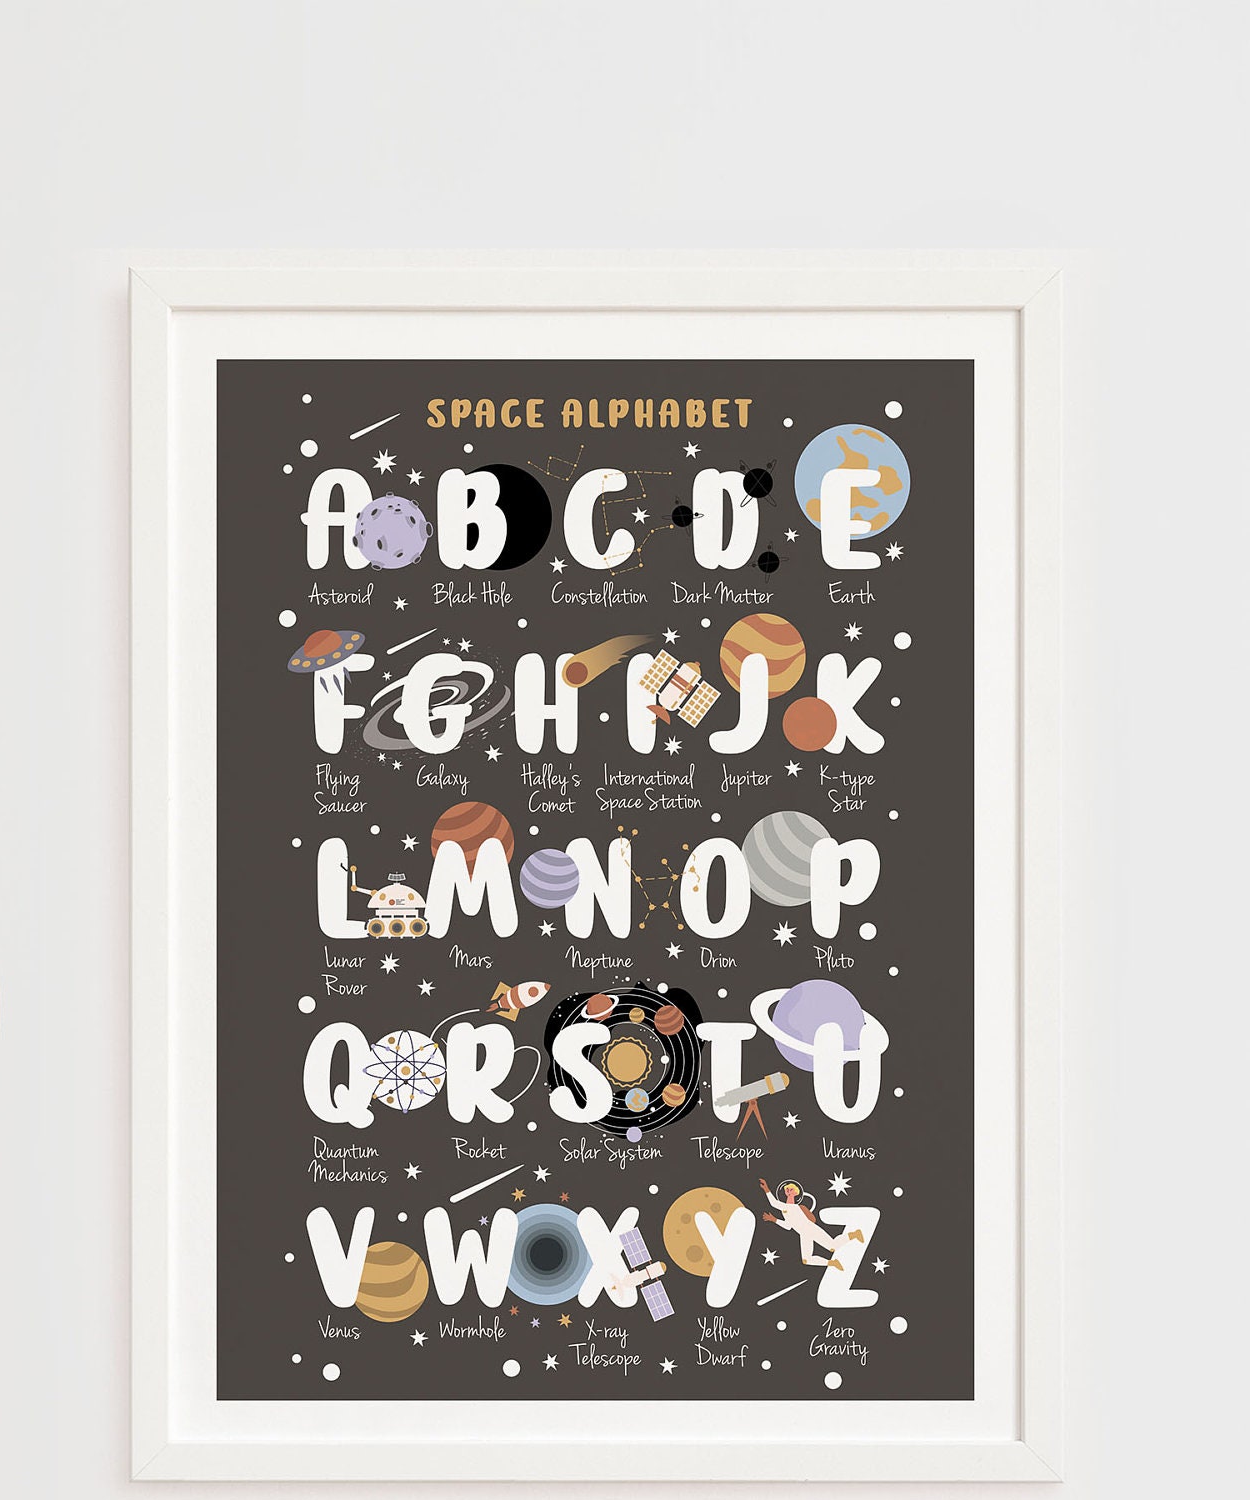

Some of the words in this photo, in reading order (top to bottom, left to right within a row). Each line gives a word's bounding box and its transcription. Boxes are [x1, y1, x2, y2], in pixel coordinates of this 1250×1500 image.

[426, 398, 545, 429] SPACE
[561, 398, 753, 429] ALPHABET
[300, 468, 373, 570] A
[437, 468, 508, 570] B
[563, 468, 635, 570] C
[692, 468, 760, 570] D
[820, 468, 882, 570] E
[308, 582, 373, 605] Asteroid
[432, 581, 477, 607] Black
[481, 581, 513, 607] Hole
[552, 581, 647, 607] Constellation
[671, 582, 710, 604] Dark
[713, 581, 773, 604] Matter
[829, 581, 875, 604] Earth
[314, 653, 375, 754] F
[393, 652, 473, 755] G
[515, 653, 579, 755] H
[626, 652, 657, 755] I
[708, 652, 769, 755] J
[816, 653, 885, 755] K
[316, 763, 361, 797] Flying
[417, 763, 470, 795] Galaxy
[521, 763, 581, 795] Halley's
[602, 763, 695, 788] International
[721, 764, 772, 796] Jupiter
[820, 765, 875, 795] K-type
[314, 791, 367, 814] Saucer
[529, 790, 576, 813] Comet
[596, 788, 643, 820] Space
[645, 788, 702, 811] Station
[828, 789, 867, 812] Star
[317, 837, 370, 939] L
[424, 837, 519, 940] M
[565, 837, 632, 940] N
[680, 837, 751, 940] O
[810, 837, 881, 940] P
[325, 946, 366, 968] Lunar
[449, 945, 492, 968] Mars
[565, 946, 633, 978] Neptune
[700, 947, 737, 967] Orion
[813, 946, 854, 971] Pluto
[322, 974, 367, 995] Rover
[303, 1022, 375, 1129] Q
[447, 1022, 515, 1124] R
[549, 1022, 613, 1124] S
[696, 1022, 757, 1123] T
[813, 1022, 882, 1124] U
[314, 1136, 379, 1160] Quantum
[451, 1137, 507, 1159] Rocket
[560, 1137, 601, 1162] Solar
[603, 1137, 663, 1169] System
[691, 1136, 763, 1168] Telescope
[823, 1137, 876, 1160] Uranus
[308, 1157, 388, 1183] Mechanics
[306, 1206, 375, 1308] V
[423, 1206, 518, 1308] W
[577, 1206, 640, 1308] X
[694, 1206, 756, 1308] Y
[817, 1206, 881, 1308] Z
[318, 1315, 361, 1339] Venus
[440, 1315, 506, 1341] Wormhole
[584, 1318, 629, 1345] X-ray
[698, 1316, 740, 1341] Yellow
[822, 1317, 854, 1338] Zero
[568, 1341, 641, 1376] Telescope
[695, 1343, 748, 1367] Dwarf
[810, 1335, 869, 1366] Gravity
